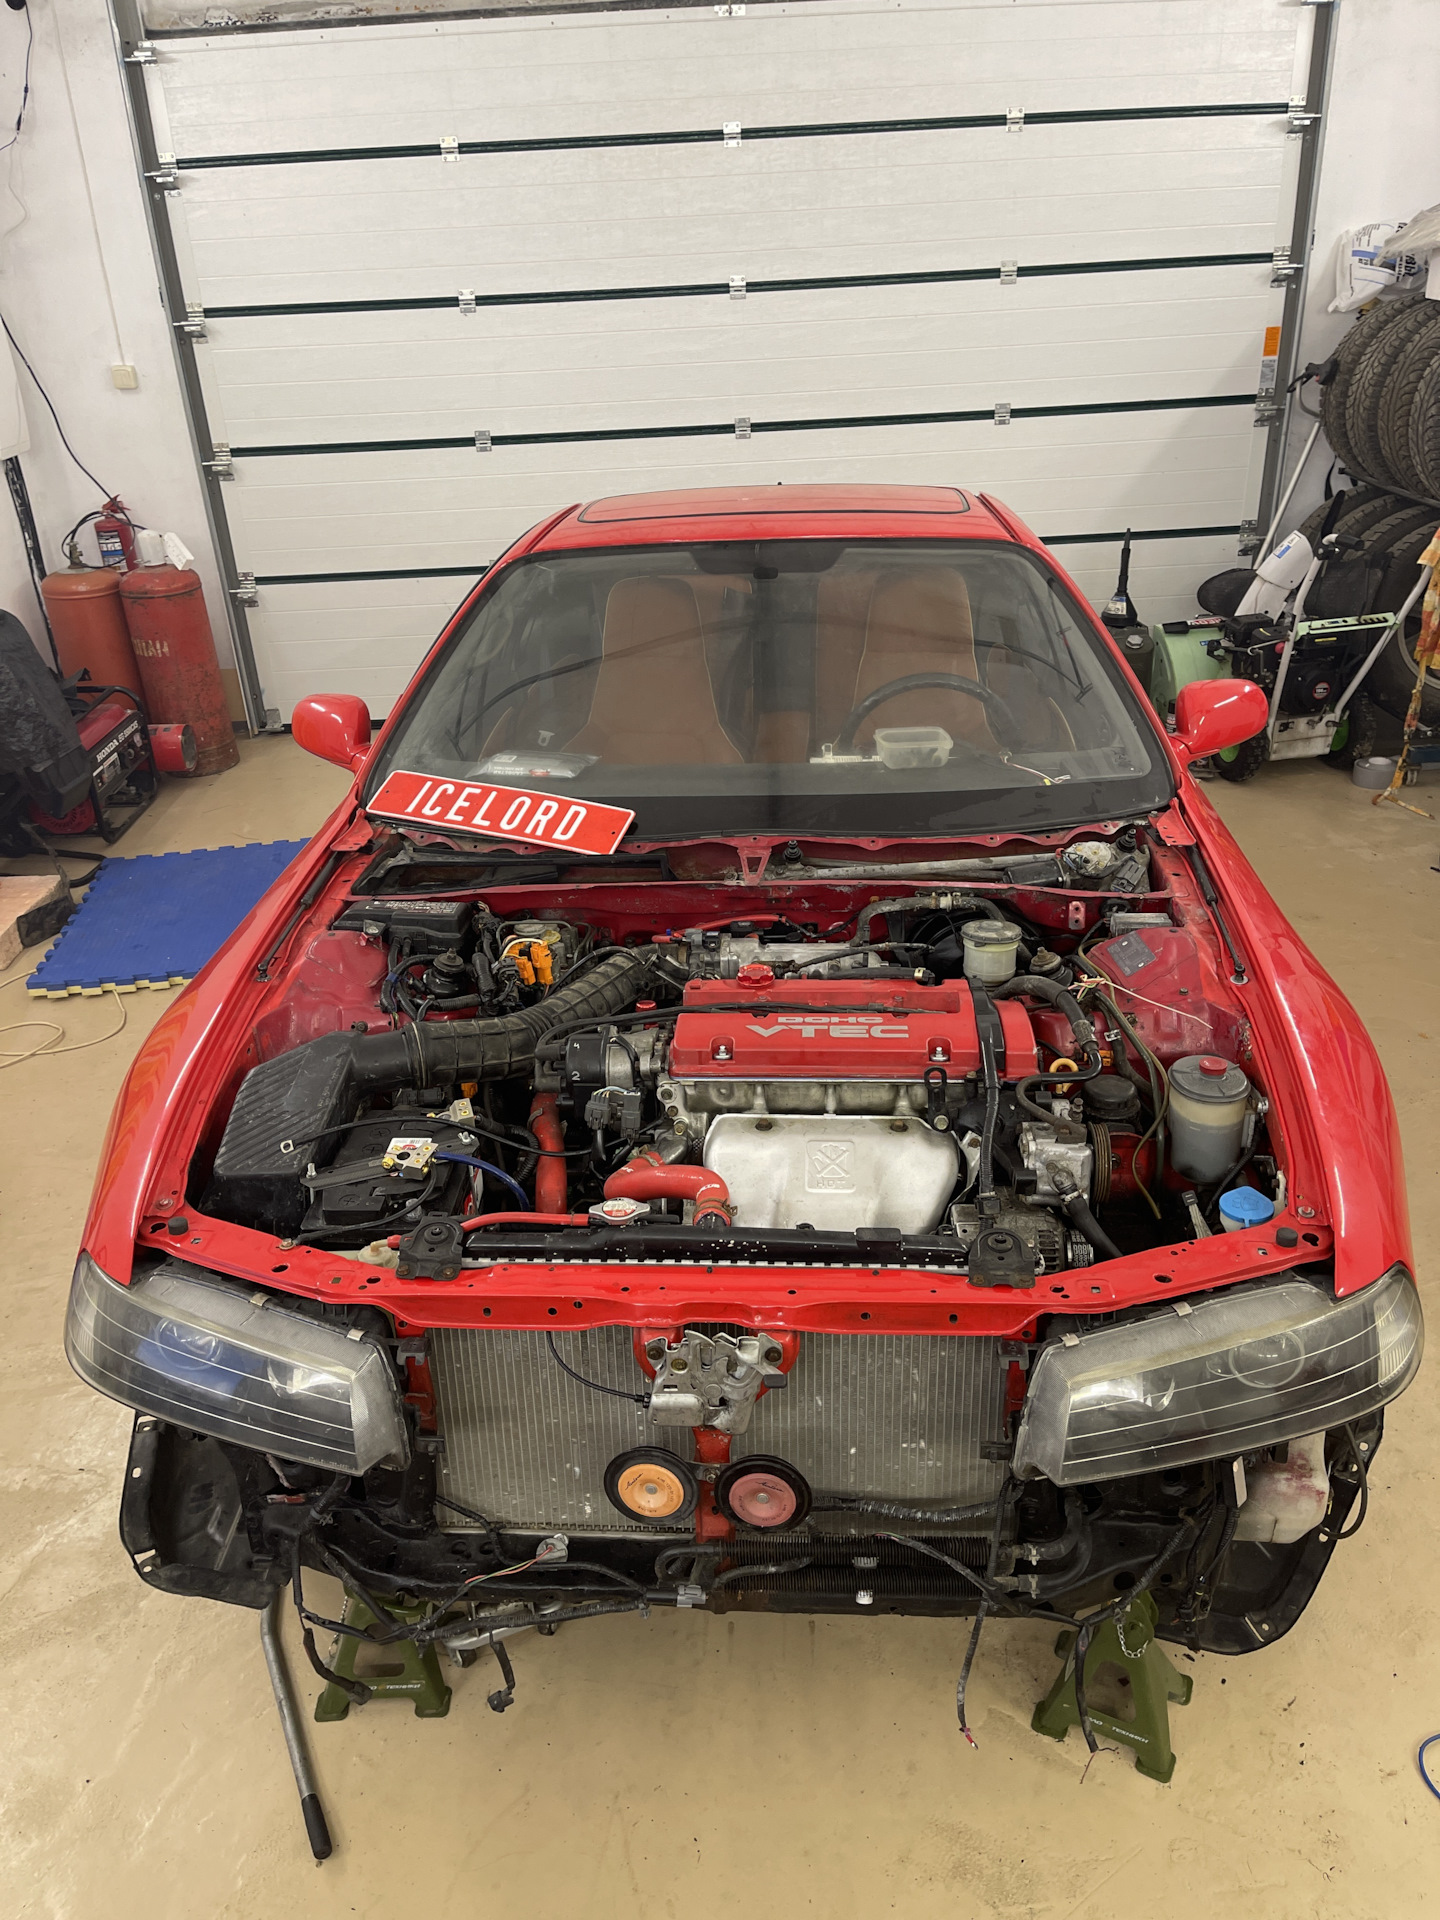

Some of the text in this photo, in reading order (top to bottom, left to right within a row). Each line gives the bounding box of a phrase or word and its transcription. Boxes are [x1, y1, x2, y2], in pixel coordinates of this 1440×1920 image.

[96, 739, 119, 763] HONDA
[404, 780, 588, 841] ICELORD
[777, 1016, 884, 1024] DOHC
[745, 1024, 909, 1038] VTEC
[571, 1070, 580, 1081] 2
